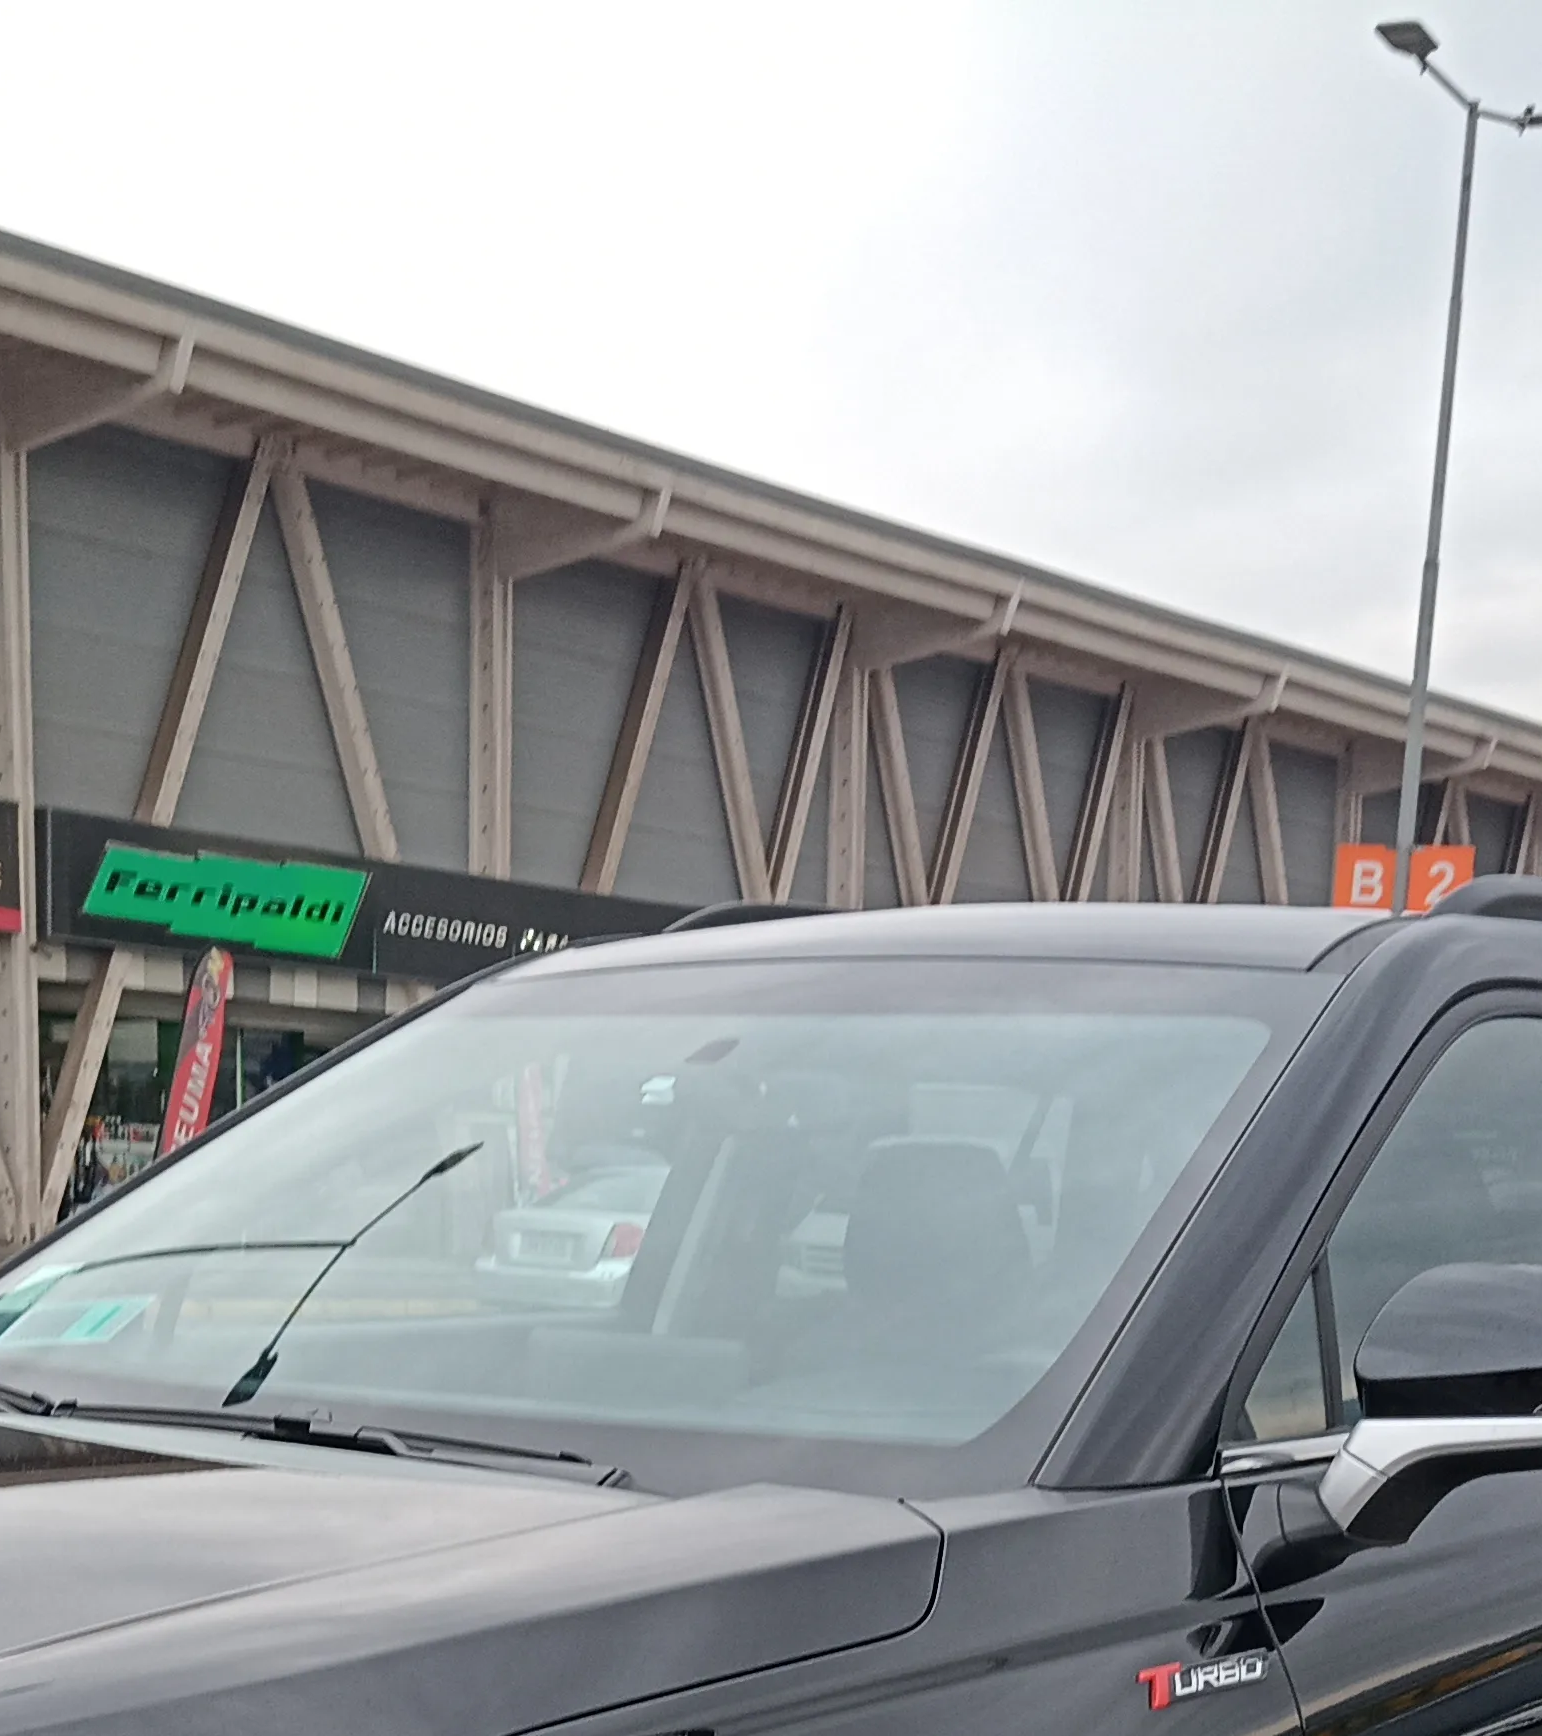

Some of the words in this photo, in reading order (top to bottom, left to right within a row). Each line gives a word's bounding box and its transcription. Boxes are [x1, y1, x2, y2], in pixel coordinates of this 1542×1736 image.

[105, 869, 345, 926] Ferripaldi
[1350, 859, 1384, 905] B
[1424, 860, 1455, 905] 2
[1136, 1660, 1263, 1712] TURBO
